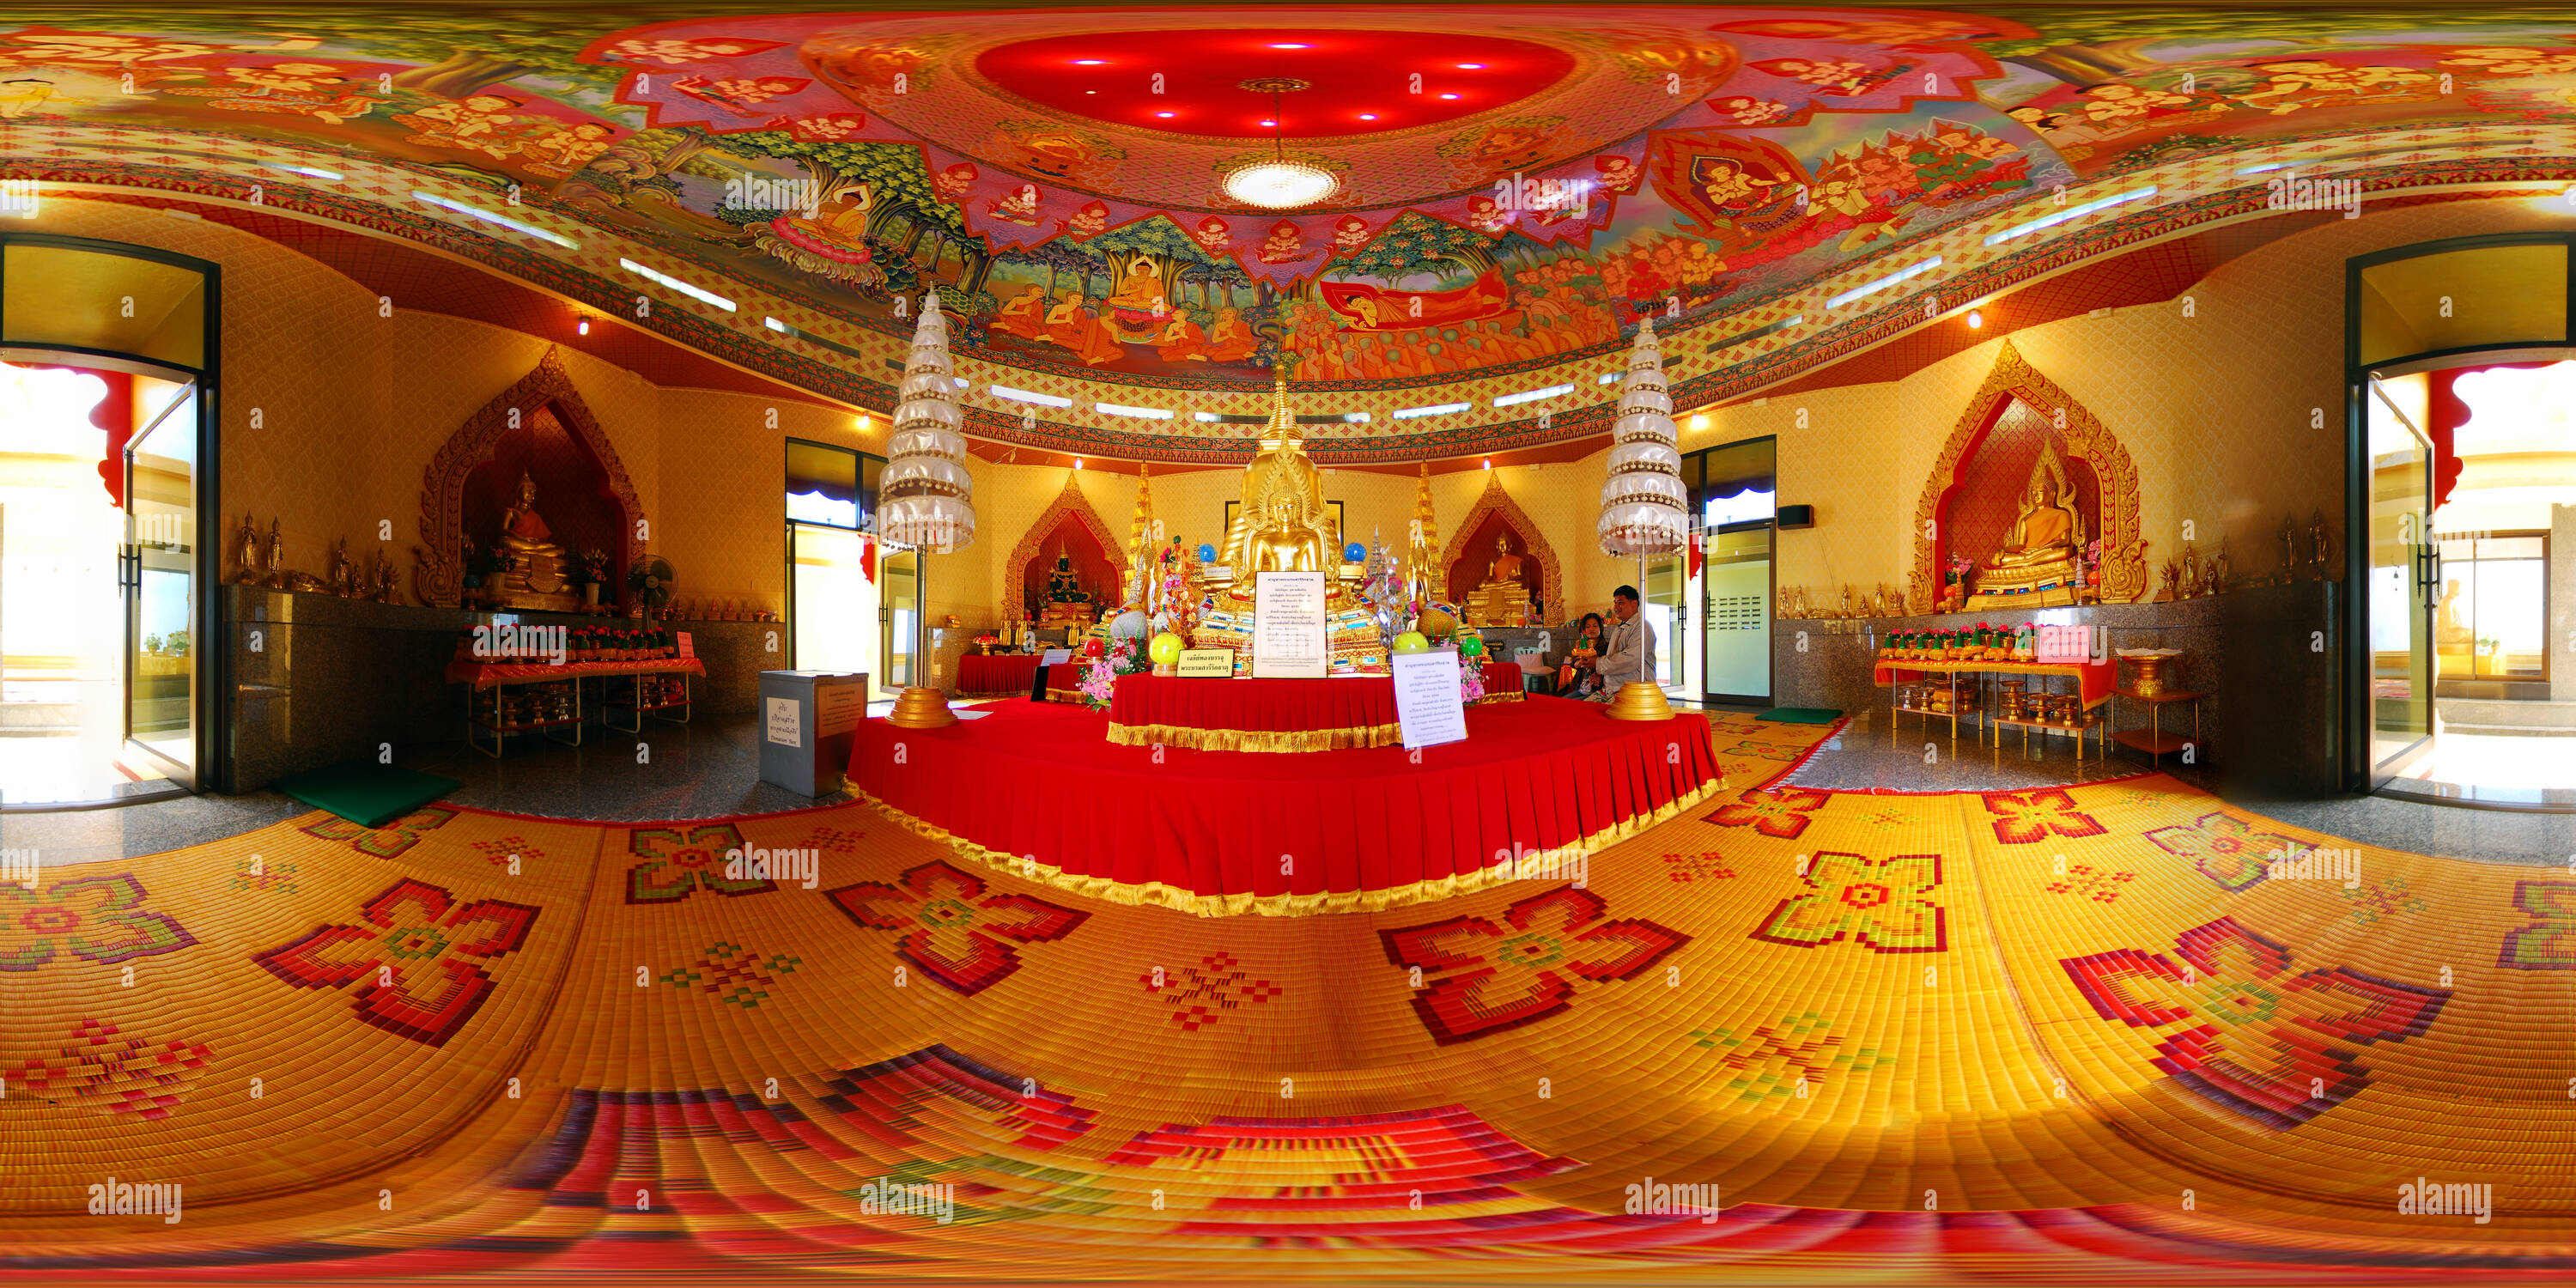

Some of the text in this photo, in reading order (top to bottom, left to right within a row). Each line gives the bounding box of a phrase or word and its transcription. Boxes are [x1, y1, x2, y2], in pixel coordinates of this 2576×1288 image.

[1187, 653, 1224, 663] เจดีย์ทองบรรจุ
[1181, 663, 1229, 672] พระบรมสารีริกธาตุ
